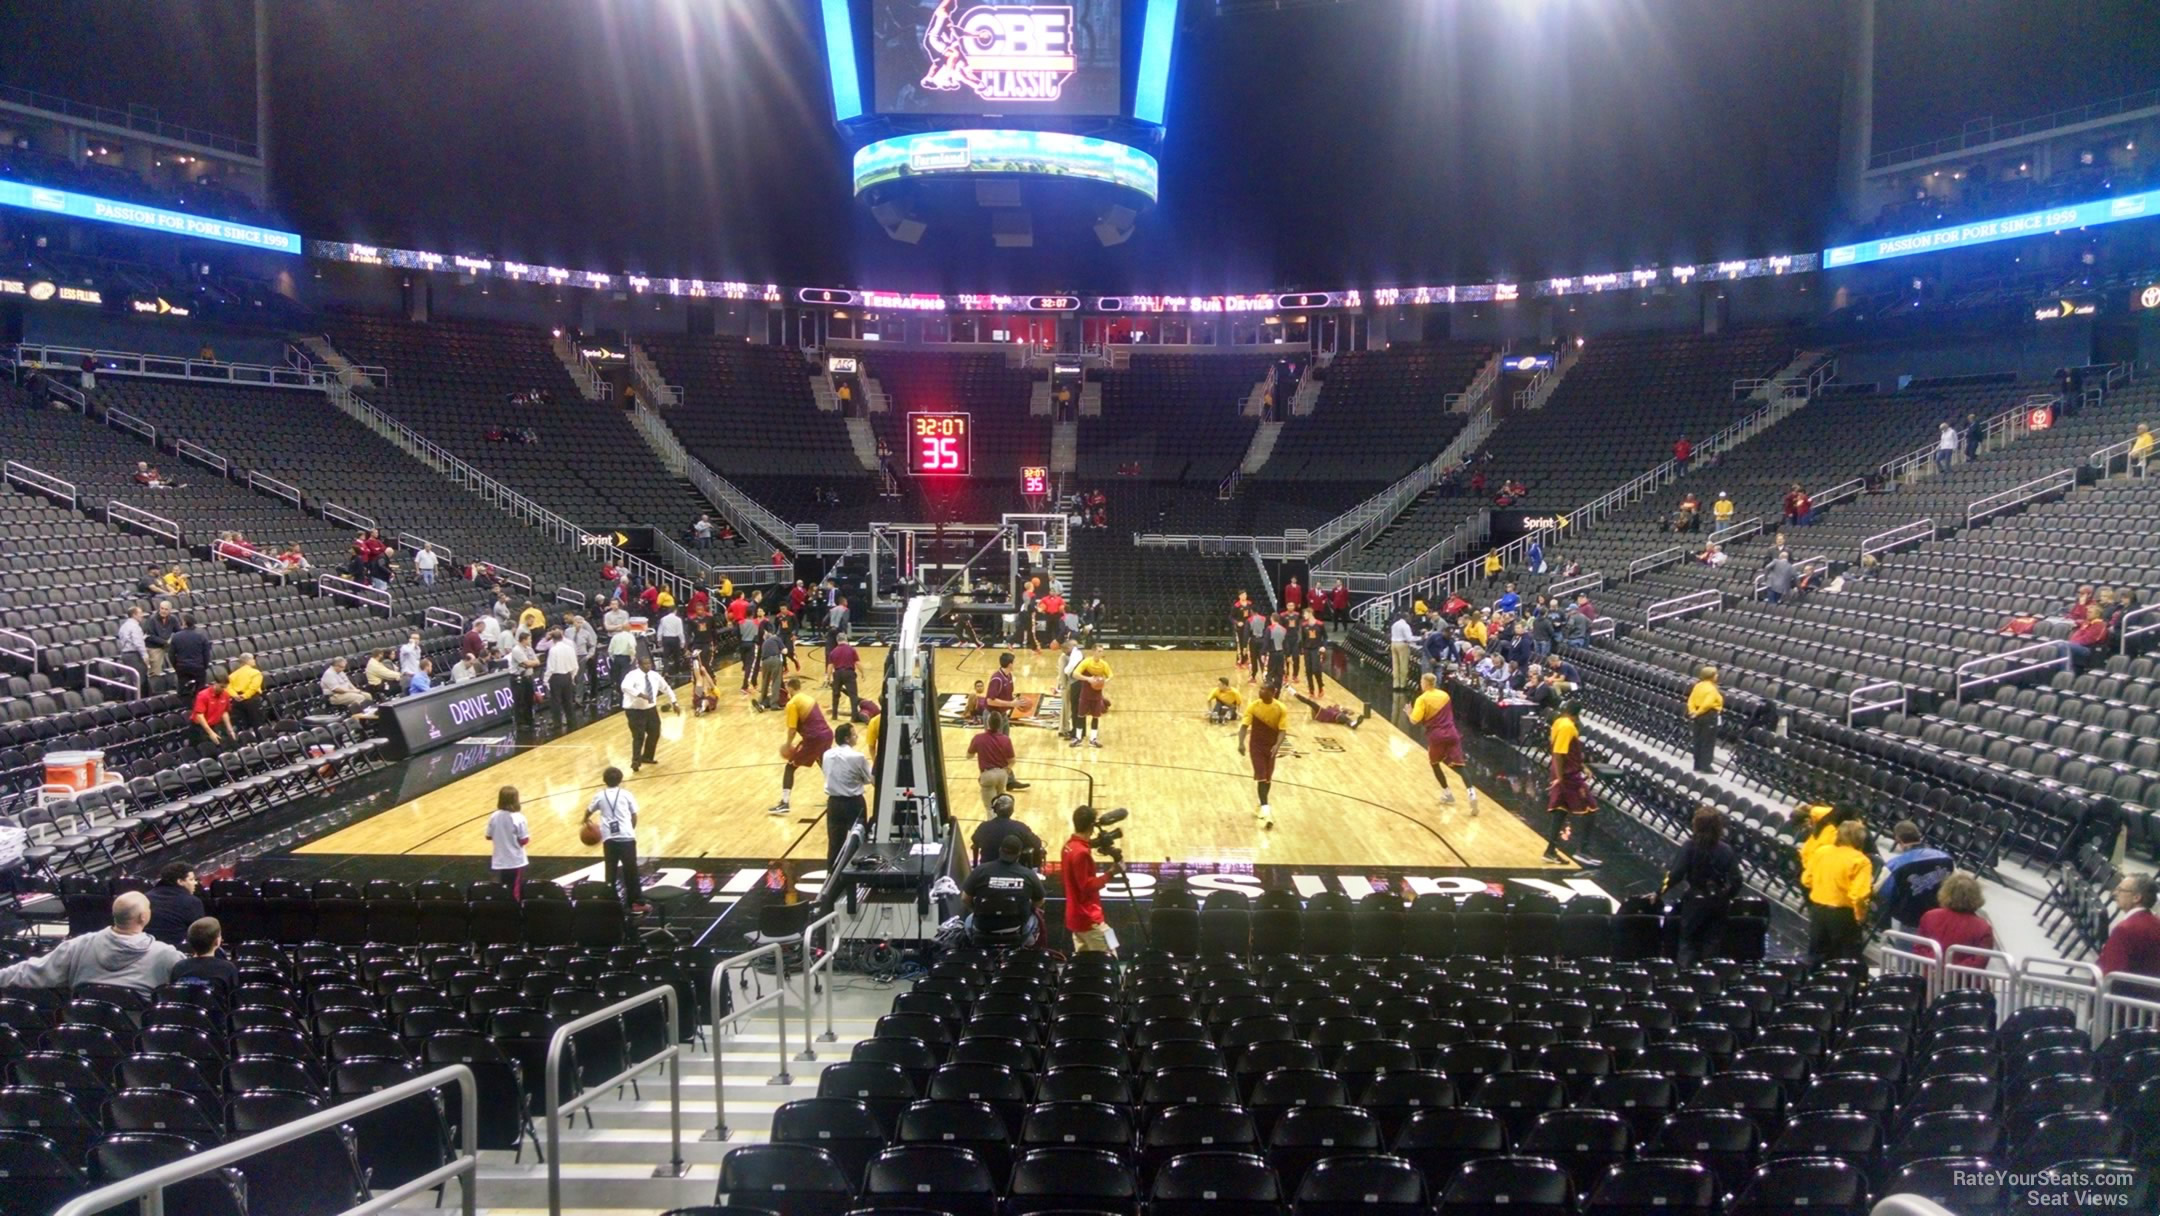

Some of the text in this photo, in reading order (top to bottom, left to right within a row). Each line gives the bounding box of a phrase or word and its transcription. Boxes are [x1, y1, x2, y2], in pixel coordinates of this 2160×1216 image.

[963, 13, 1066, 55] CBE
[981, 71, 1059, 97] CLASSIC
[96, 202, 289, 248] PASSION FOR PORK SINCE 1959
[1880, 209, 2078, 254] PASSION FOR PORK SINCE 1959
[823, 291, 831, 301] 0
[1041, 298, 1068, 307] 32:07
[916, 418, 964, 435] 32:07
[922, 437, 958, 469] 35
[1023, 469, 1045, 477] 32:07
[1026, 478, 1043, 491] 35
[1523, 516, 1554, 530] Sprint
[581, 534, 613, 546] Sprint
[448, 692, 498, 725] DRIVE,
[494, 686, 515, 711] DR
[988, 876, 1024, 889] ESPN
